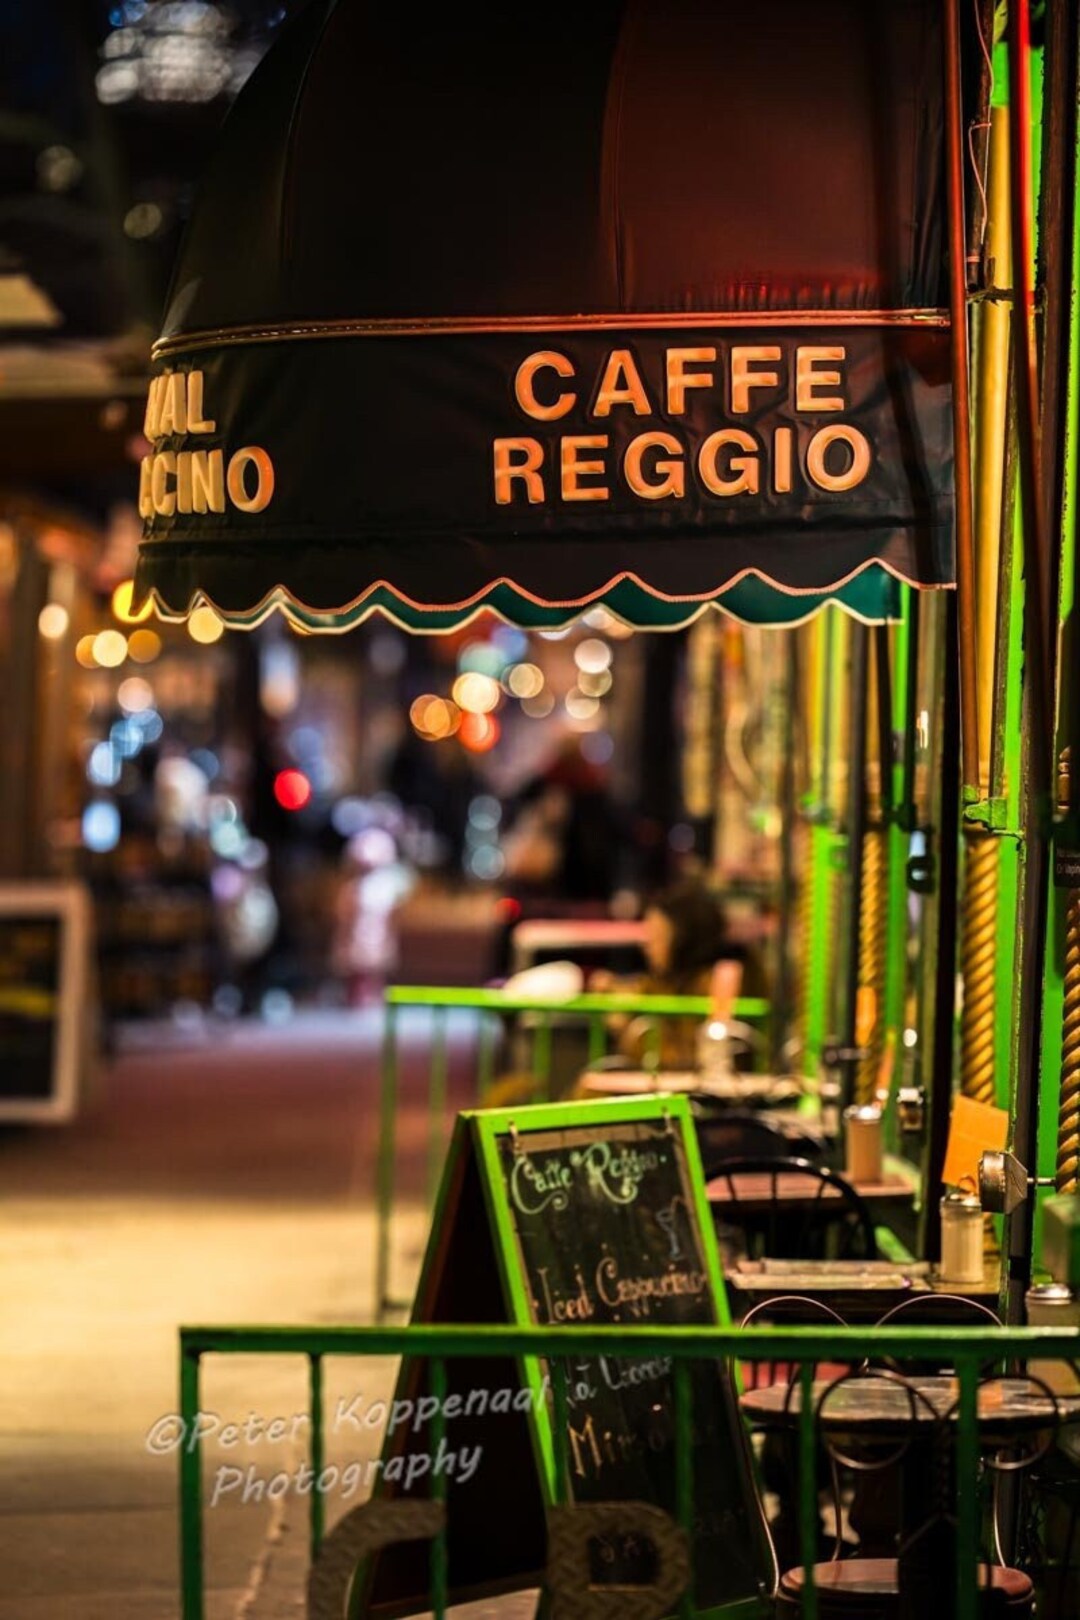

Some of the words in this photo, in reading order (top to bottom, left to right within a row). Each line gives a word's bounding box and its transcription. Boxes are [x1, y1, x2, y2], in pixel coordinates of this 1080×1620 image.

[514, 345, 846, 422] CAFFE
[492, 423, 871, 505] REGGIO
[536, 1267, 594, 1324] Iced
